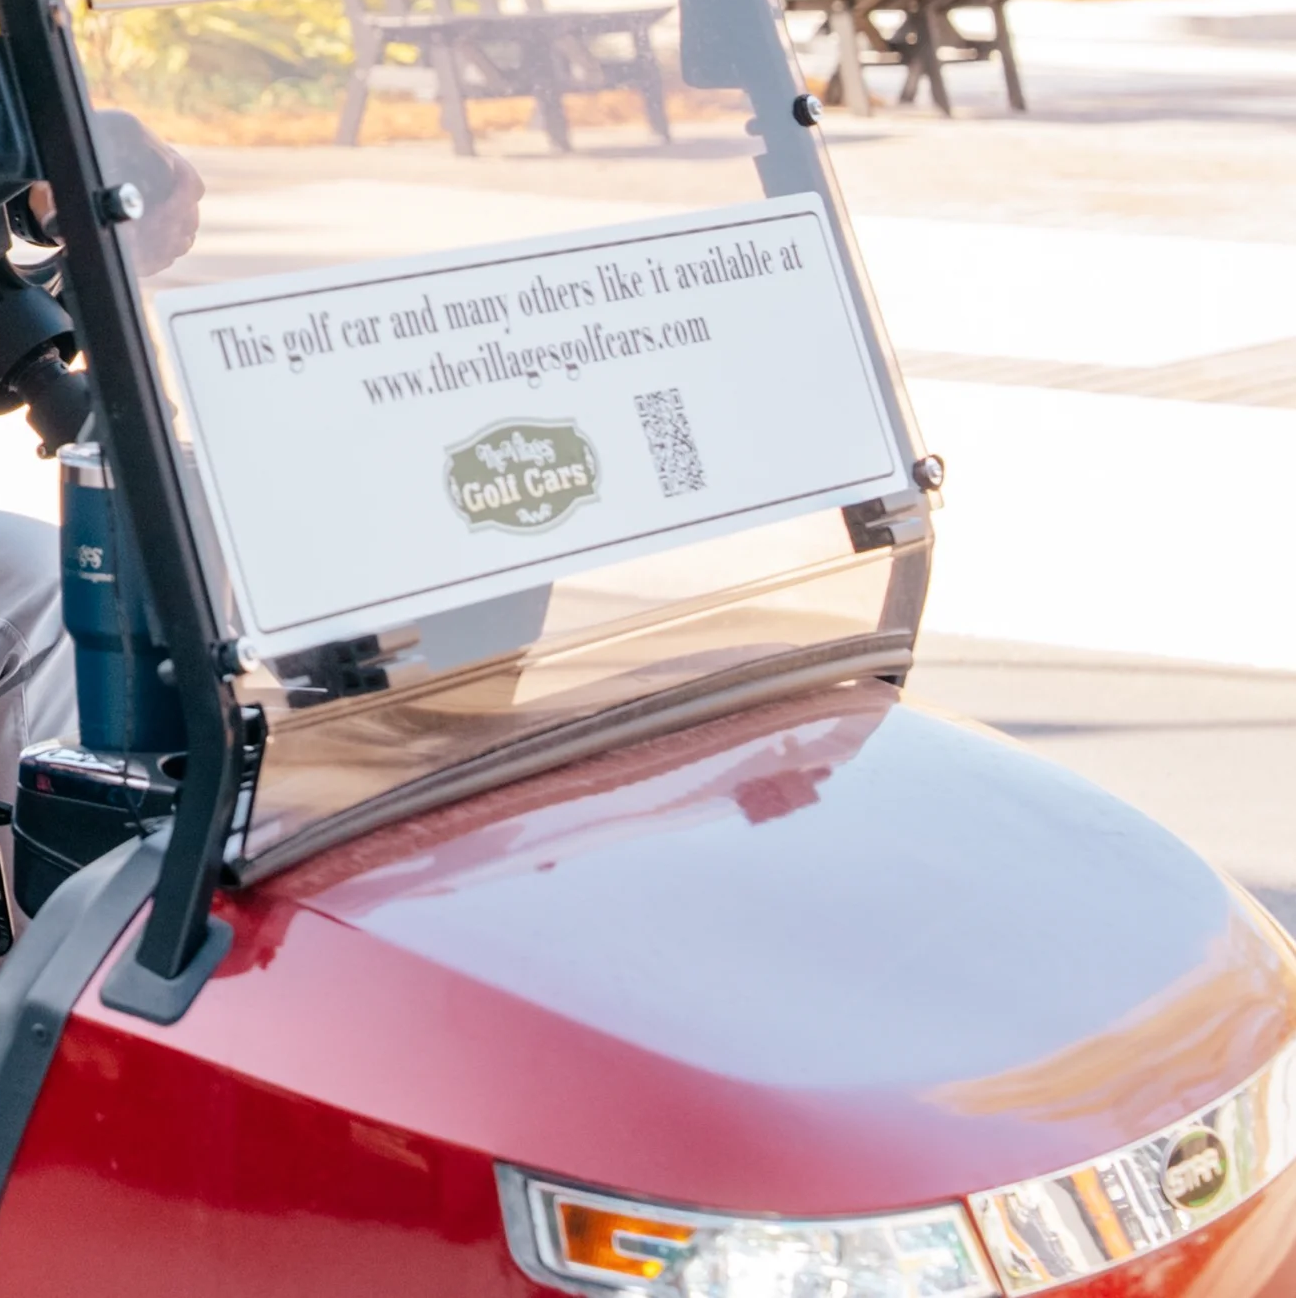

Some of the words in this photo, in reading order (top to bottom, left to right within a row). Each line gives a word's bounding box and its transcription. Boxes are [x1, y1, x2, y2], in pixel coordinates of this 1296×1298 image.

[210, 323, 277, 371] This
[282, 310, 335, 374] golf
[341, 315, 382, 348] car
[389, 293, 440, 340] and
[443, 292, 511, 335] many
[518, 275, 597, 317] others
[596, 261, 645, 303] like
[645, 257, 671, 295] it
[674, 240, 774, 290] available
[779, 237, 805, 272] at
[361, 315, 713, 405] www.thevillagesgolfcars.com
[462, 474, 522, 513] Golf
[523, 463, 588, 498] Cars
